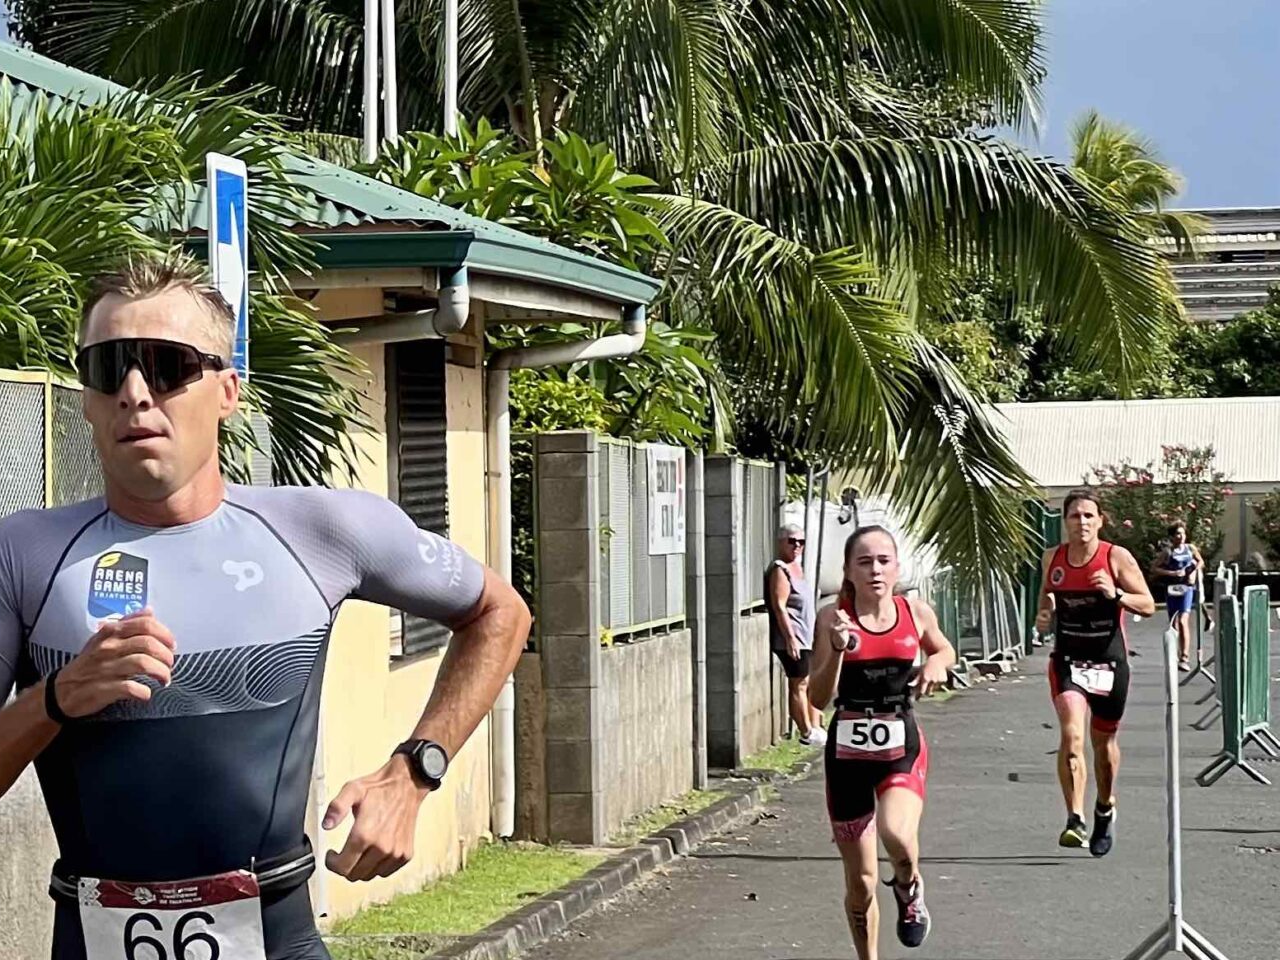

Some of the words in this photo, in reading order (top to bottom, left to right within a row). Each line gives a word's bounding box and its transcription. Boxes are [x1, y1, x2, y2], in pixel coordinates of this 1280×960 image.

[95, 567, 144, 583] ARENA
[93, 580, 143, 594] GAMES
[94, 592, 142, 600] TRIATHLON
[850, 722, 890, 746] 50
